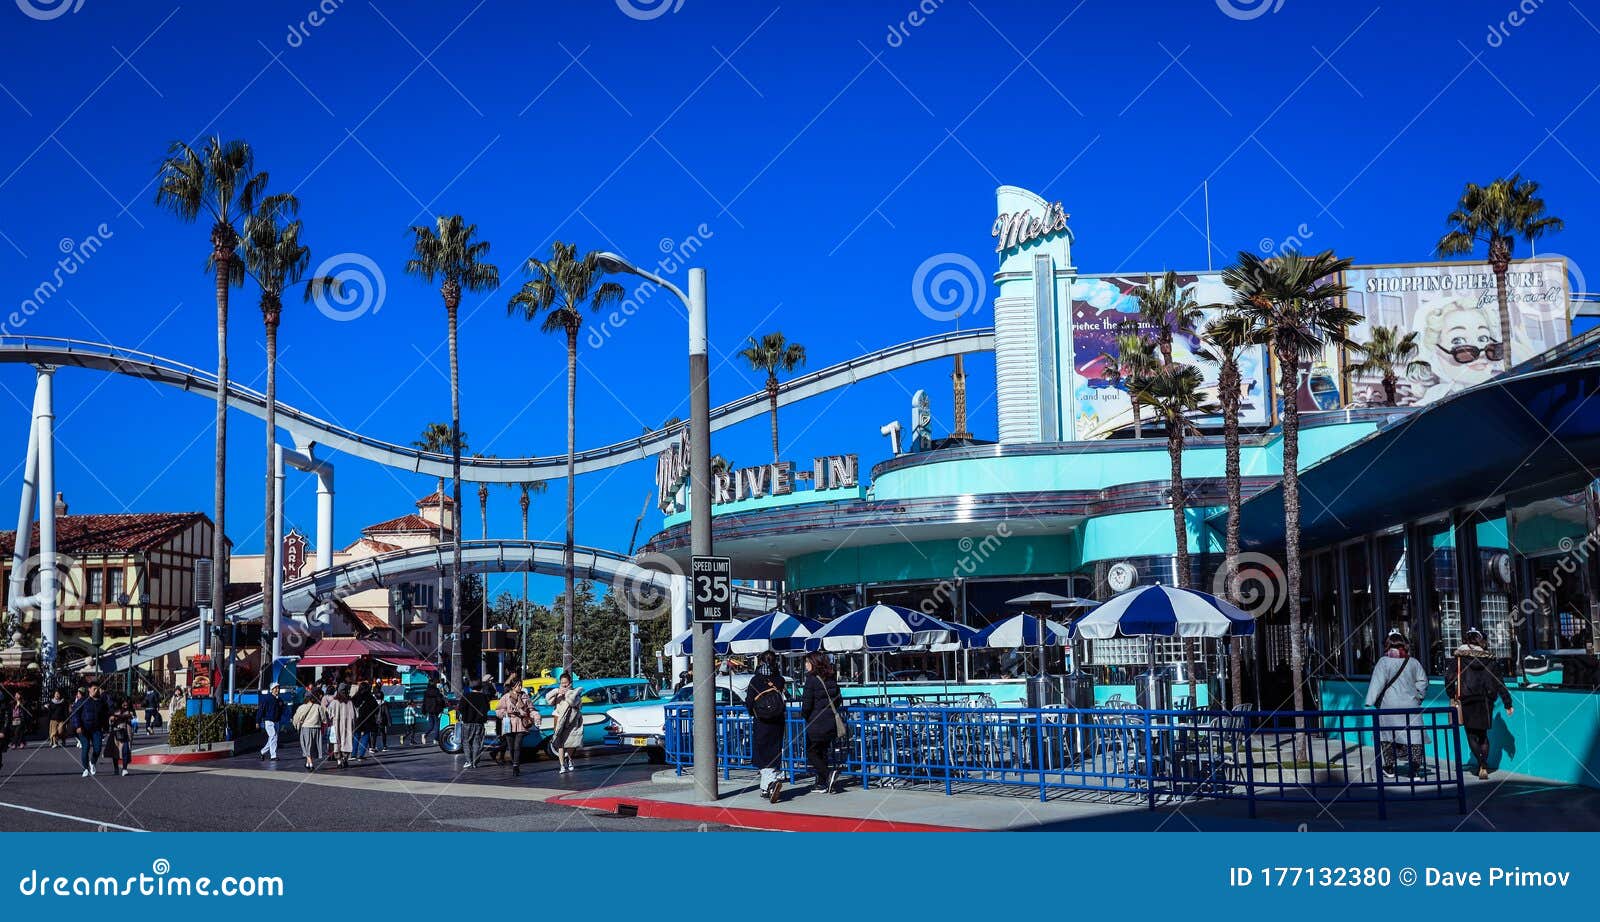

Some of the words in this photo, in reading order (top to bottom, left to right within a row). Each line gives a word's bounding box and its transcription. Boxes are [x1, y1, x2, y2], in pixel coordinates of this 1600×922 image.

[991, 201, 1070, 253] Mel's
[1366, 275, 1451, 293] SHOPPING
[1455, 271, 1544, 289] PLEAURE
[1072, 320, 1100, 331] rience
[1103, 316, 1118, 330] the
[714, 454, 859, 505] RIVE-IN
[694, 561, 712, 572] SPEED
[713, 562, 729, 572] LIMIT
[696, 575, 729, 603] 35
[703, 606, 722, 617] MILES
